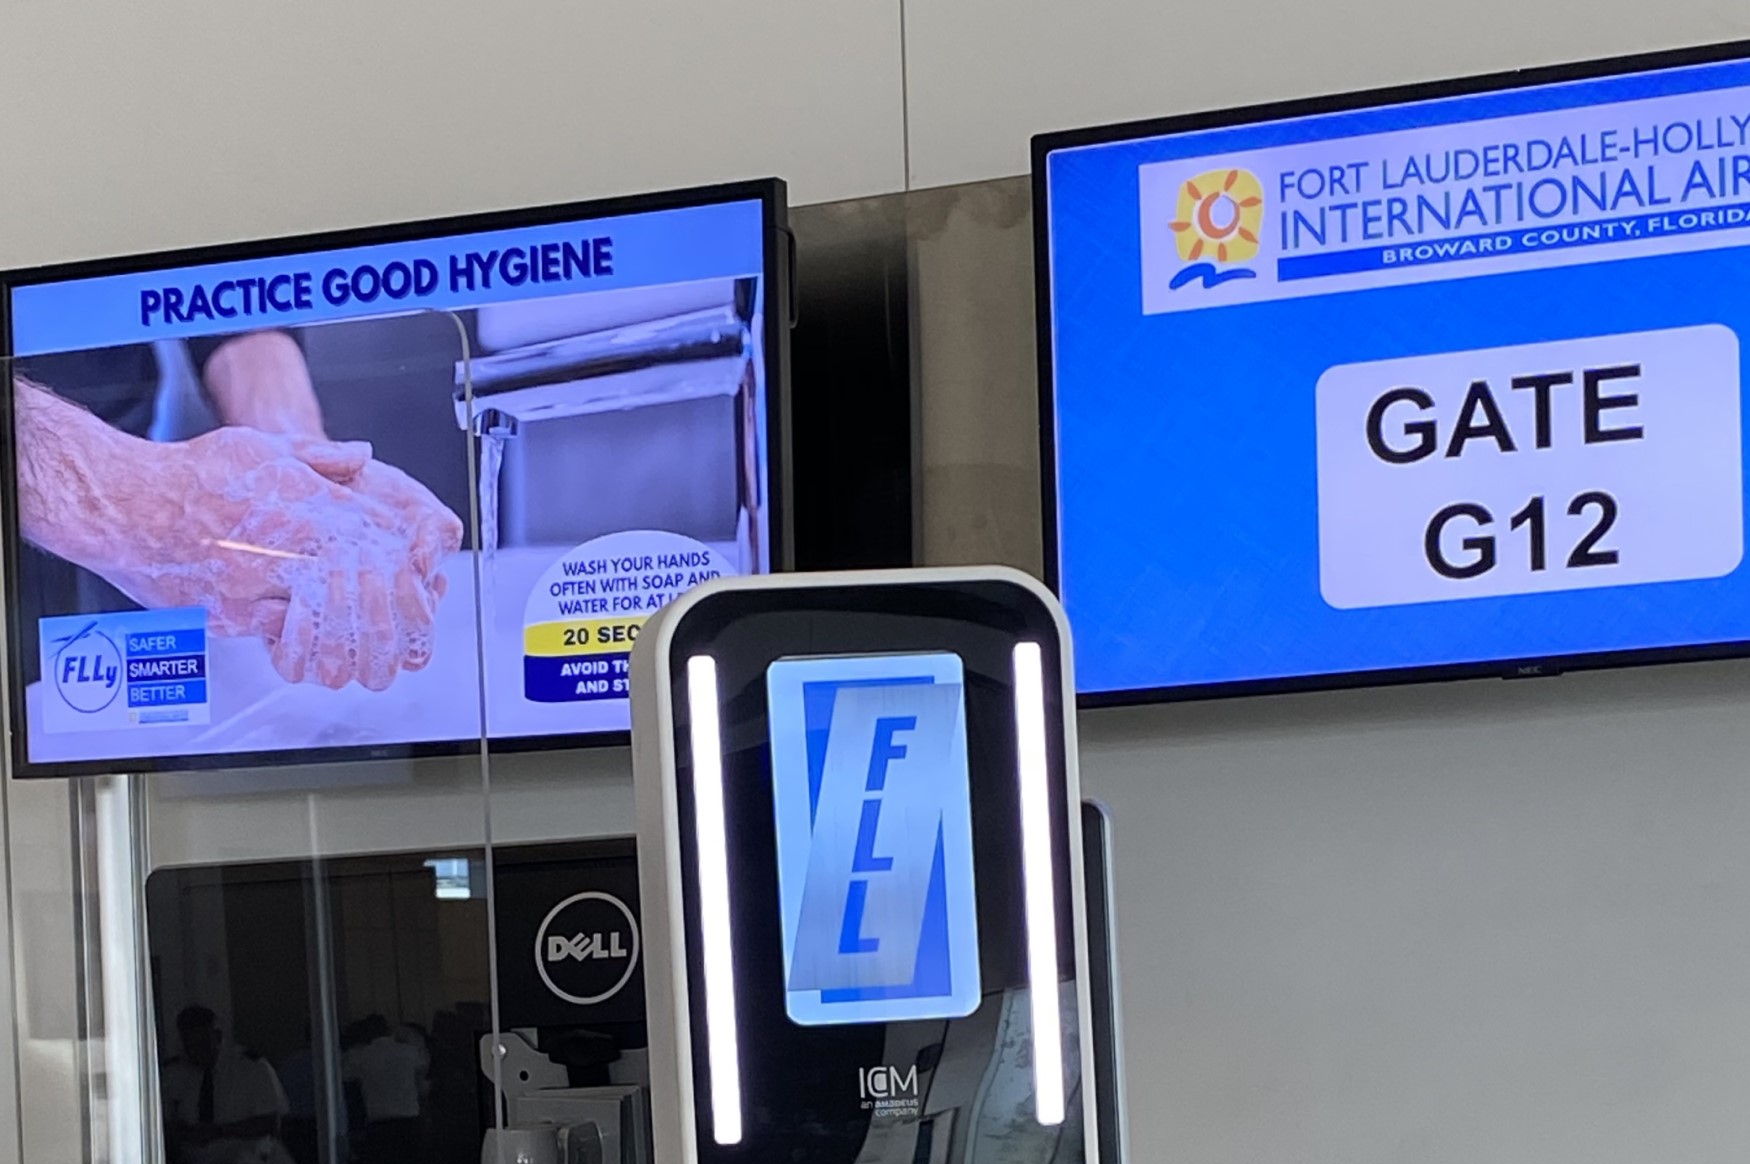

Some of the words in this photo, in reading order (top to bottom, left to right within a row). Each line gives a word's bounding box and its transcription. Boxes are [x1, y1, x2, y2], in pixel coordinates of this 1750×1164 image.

[1278, 161, 1369, 203] FORT
[1279, 168, 1672, 250] INTERNATIONAL
[1382, 235, 1512, 264] BROWARD
[1521, 220, 1641, 248] COUNTY,
[140, 271, 313, 326] PRACTICE
[321, 258, 439, 306] GOOD
[449, 236, 614, 292] HYGIENE
[1366, 363, 1644, 464] GATE
[1424, 491, 1619, 580] G12
[562, 559, 607, 576] WASH
[611, 556, 654, 573] YOUR
[657, 551, 710, 569] HANDS
[550, 580, 596, 597] OFTEN
[600, 576, 638, 593] WITH
[642, 573, 684, 590] SOAP
[558, 599, 609, 616] WATER
[613, 596, 641, 612] FOR
[646, 593, 666, 609] AT
[129, 636, 177, 652] SAFER
[563, 627, 590, 646] 20
[129, 659, 199, 678] SMARTER
[560, 661, 609, 676] AVOID
[130, 685, 186, 702] BETTER
[575, 680, 609, 695] AND
[547, 931, 628, 962] DELL
[859, 1064, 919, 1099] ICM
